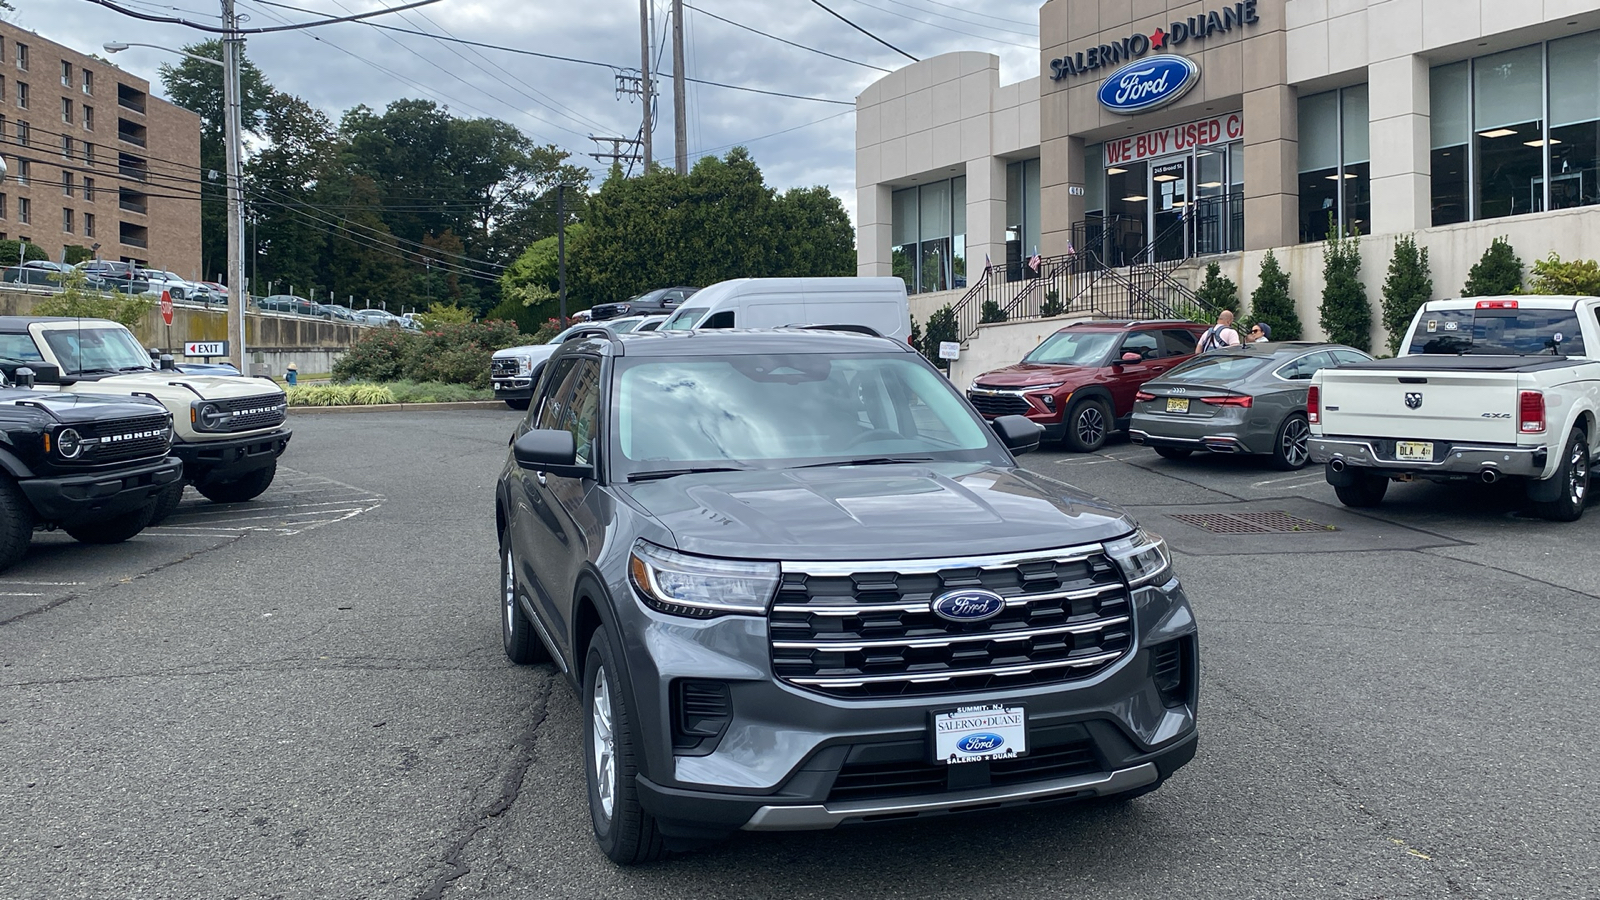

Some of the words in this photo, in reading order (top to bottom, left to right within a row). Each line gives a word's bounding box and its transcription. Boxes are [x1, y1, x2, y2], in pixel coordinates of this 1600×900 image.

[1050, 33, 1149, 81] SALERNO
[1170, 0, 1259, 45] DUANE
[1115, 67, 1170, 104] Ford
[1107, 139, 1131, 164] WE
[1137, 129, 1170, 158] BUY
[1174, 119, 1221, 150] USED
[198, 344, 219, 353] EXIT
[232, 405, 278, 416] BRONCO
[101, 429, 161, 443] BRONCO
[1400, 446, 1414, 456] DLA
[1421, 448, 1426, 456] 4
[952, 596, 989, 614] Ford
[938, 718, 982, 731] SALERNO
[987, 714, 1021, 726] DUANE
[966, 736, 994, 750] Ford
[946, 756, 982, 764] SALERNO
